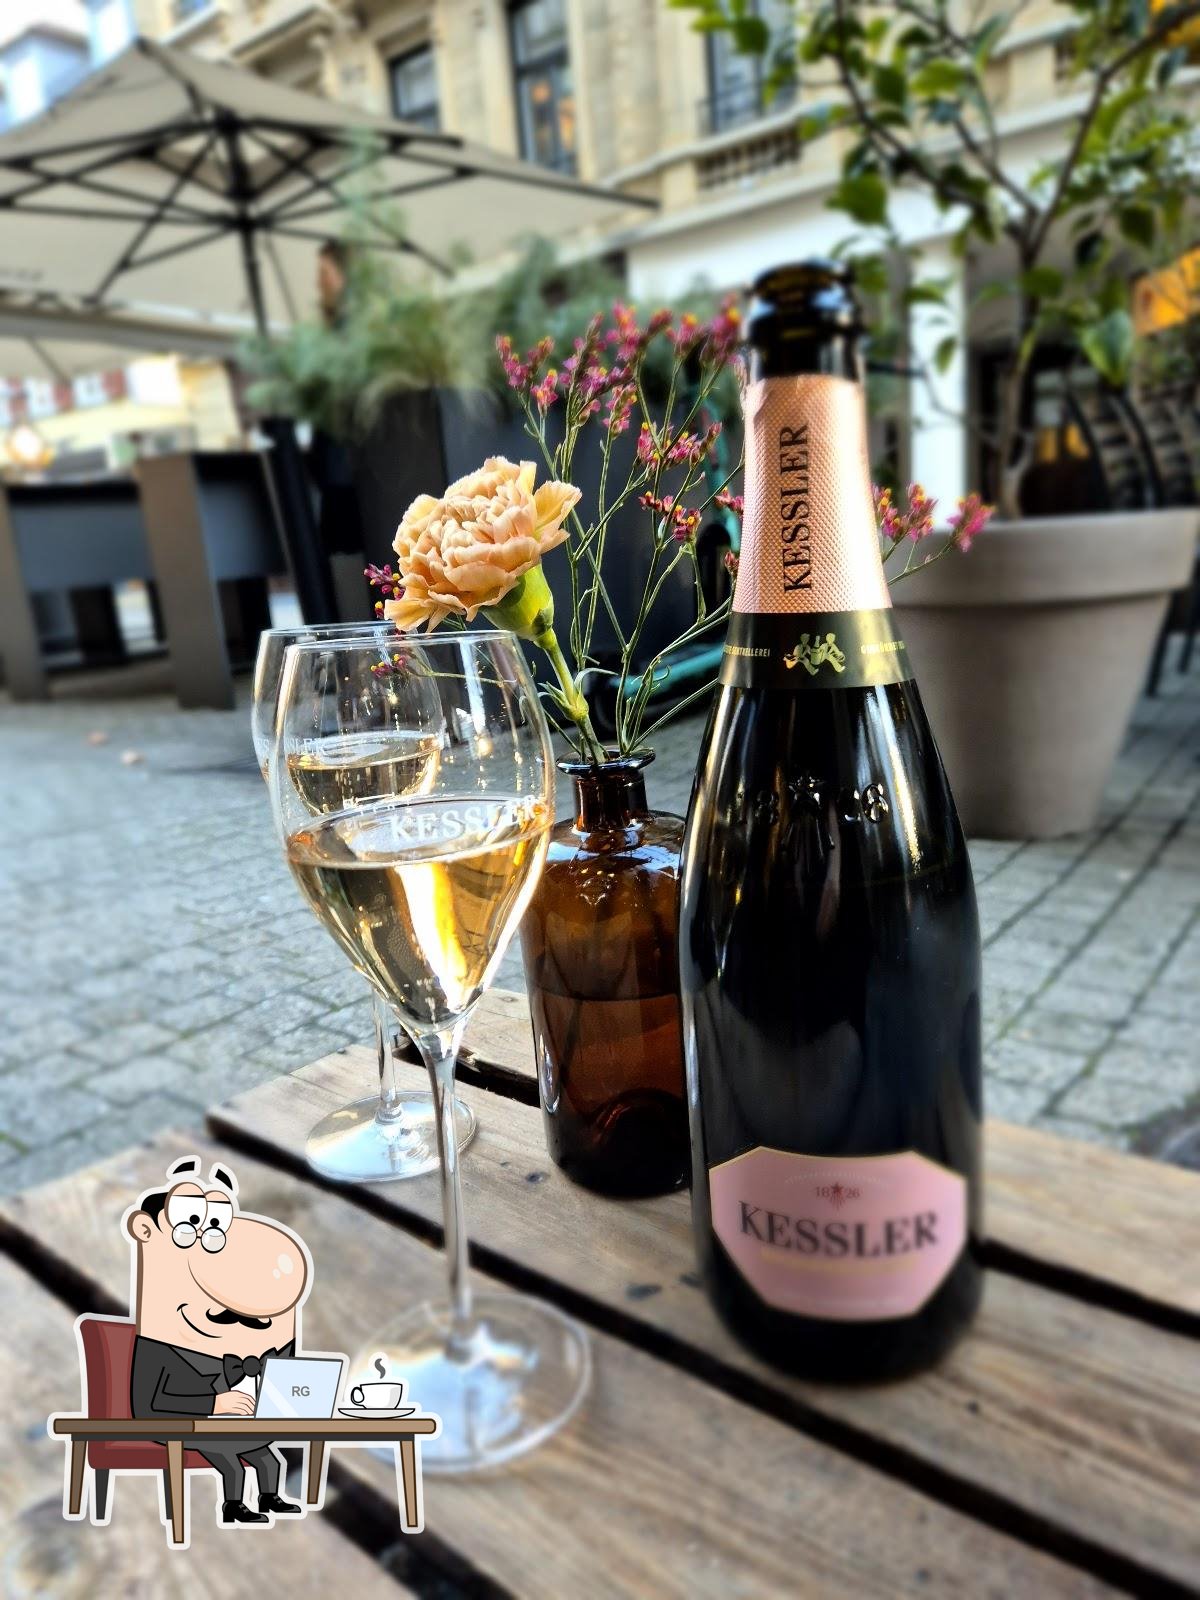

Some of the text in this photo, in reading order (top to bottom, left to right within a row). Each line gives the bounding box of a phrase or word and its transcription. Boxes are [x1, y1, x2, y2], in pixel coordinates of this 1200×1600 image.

[779, 424, 813, 592] KESSLER
[816, 1185, 831, 1198] 18
[738, 1200, 939, 1259] KESSLER
